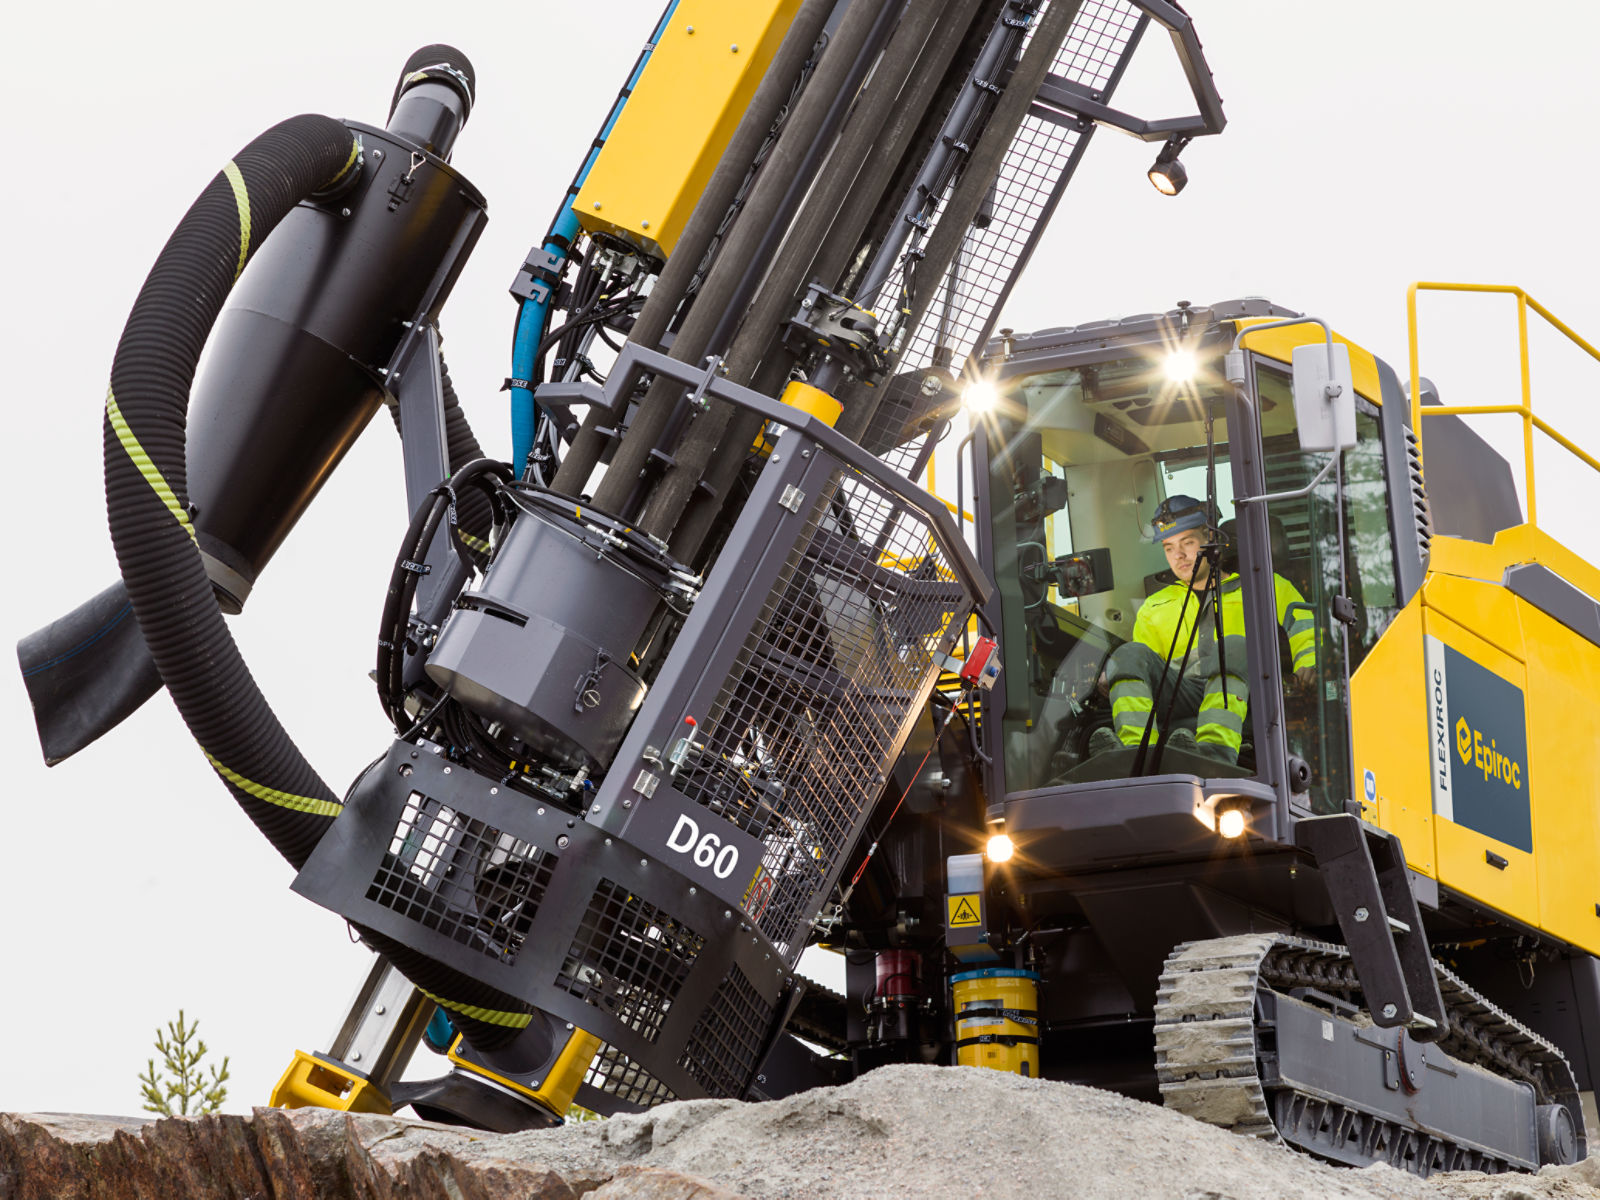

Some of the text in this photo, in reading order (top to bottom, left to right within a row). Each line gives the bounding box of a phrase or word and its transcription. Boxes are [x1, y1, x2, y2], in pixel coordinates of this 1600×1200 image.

[1434, 669, 1448, 791] FLEXIROC
[1473, 729, 1521, 790] Epiroc
[666, 813, 739, 879] D60
